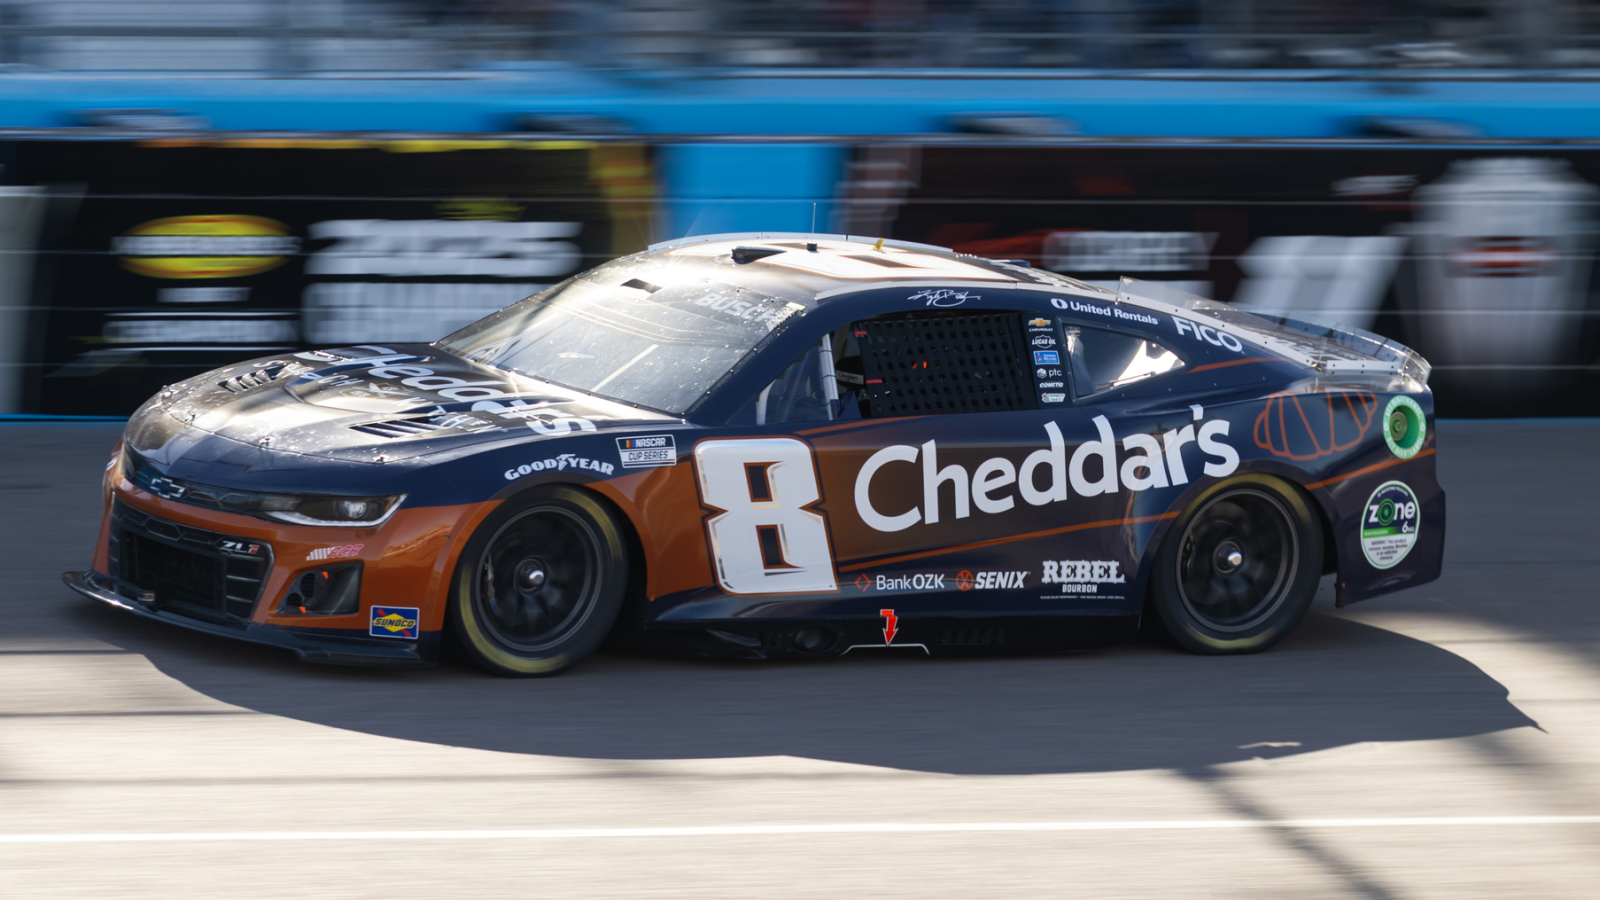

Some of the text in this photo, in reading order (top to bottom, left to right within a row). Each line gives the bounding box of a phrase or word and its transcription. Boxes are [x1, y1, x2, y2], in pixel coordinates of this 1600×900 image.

[1070, 301, 1159, 325] United Rentals
[1171, 315, 1243, 352] FICO
[1048, 368, 1062, 378] ptc
[635, 437, 666, 448] NASCAR
[628, 451, 668, 461] CUP SERIES
[504, 455, 615, 481] GOODYEAR
[855, 403, 1240, 532] Cheddar's
[695, 437, 838, 594] 8
[219, 540, 260, 554] ZL1
[974, 571, 1028, 589] SENIX
[1041, 560, 1126, 584] REBEL
[1062, 584, 1098, 593] BOURBON
[374, 618, 415, 628] SUNOCO
